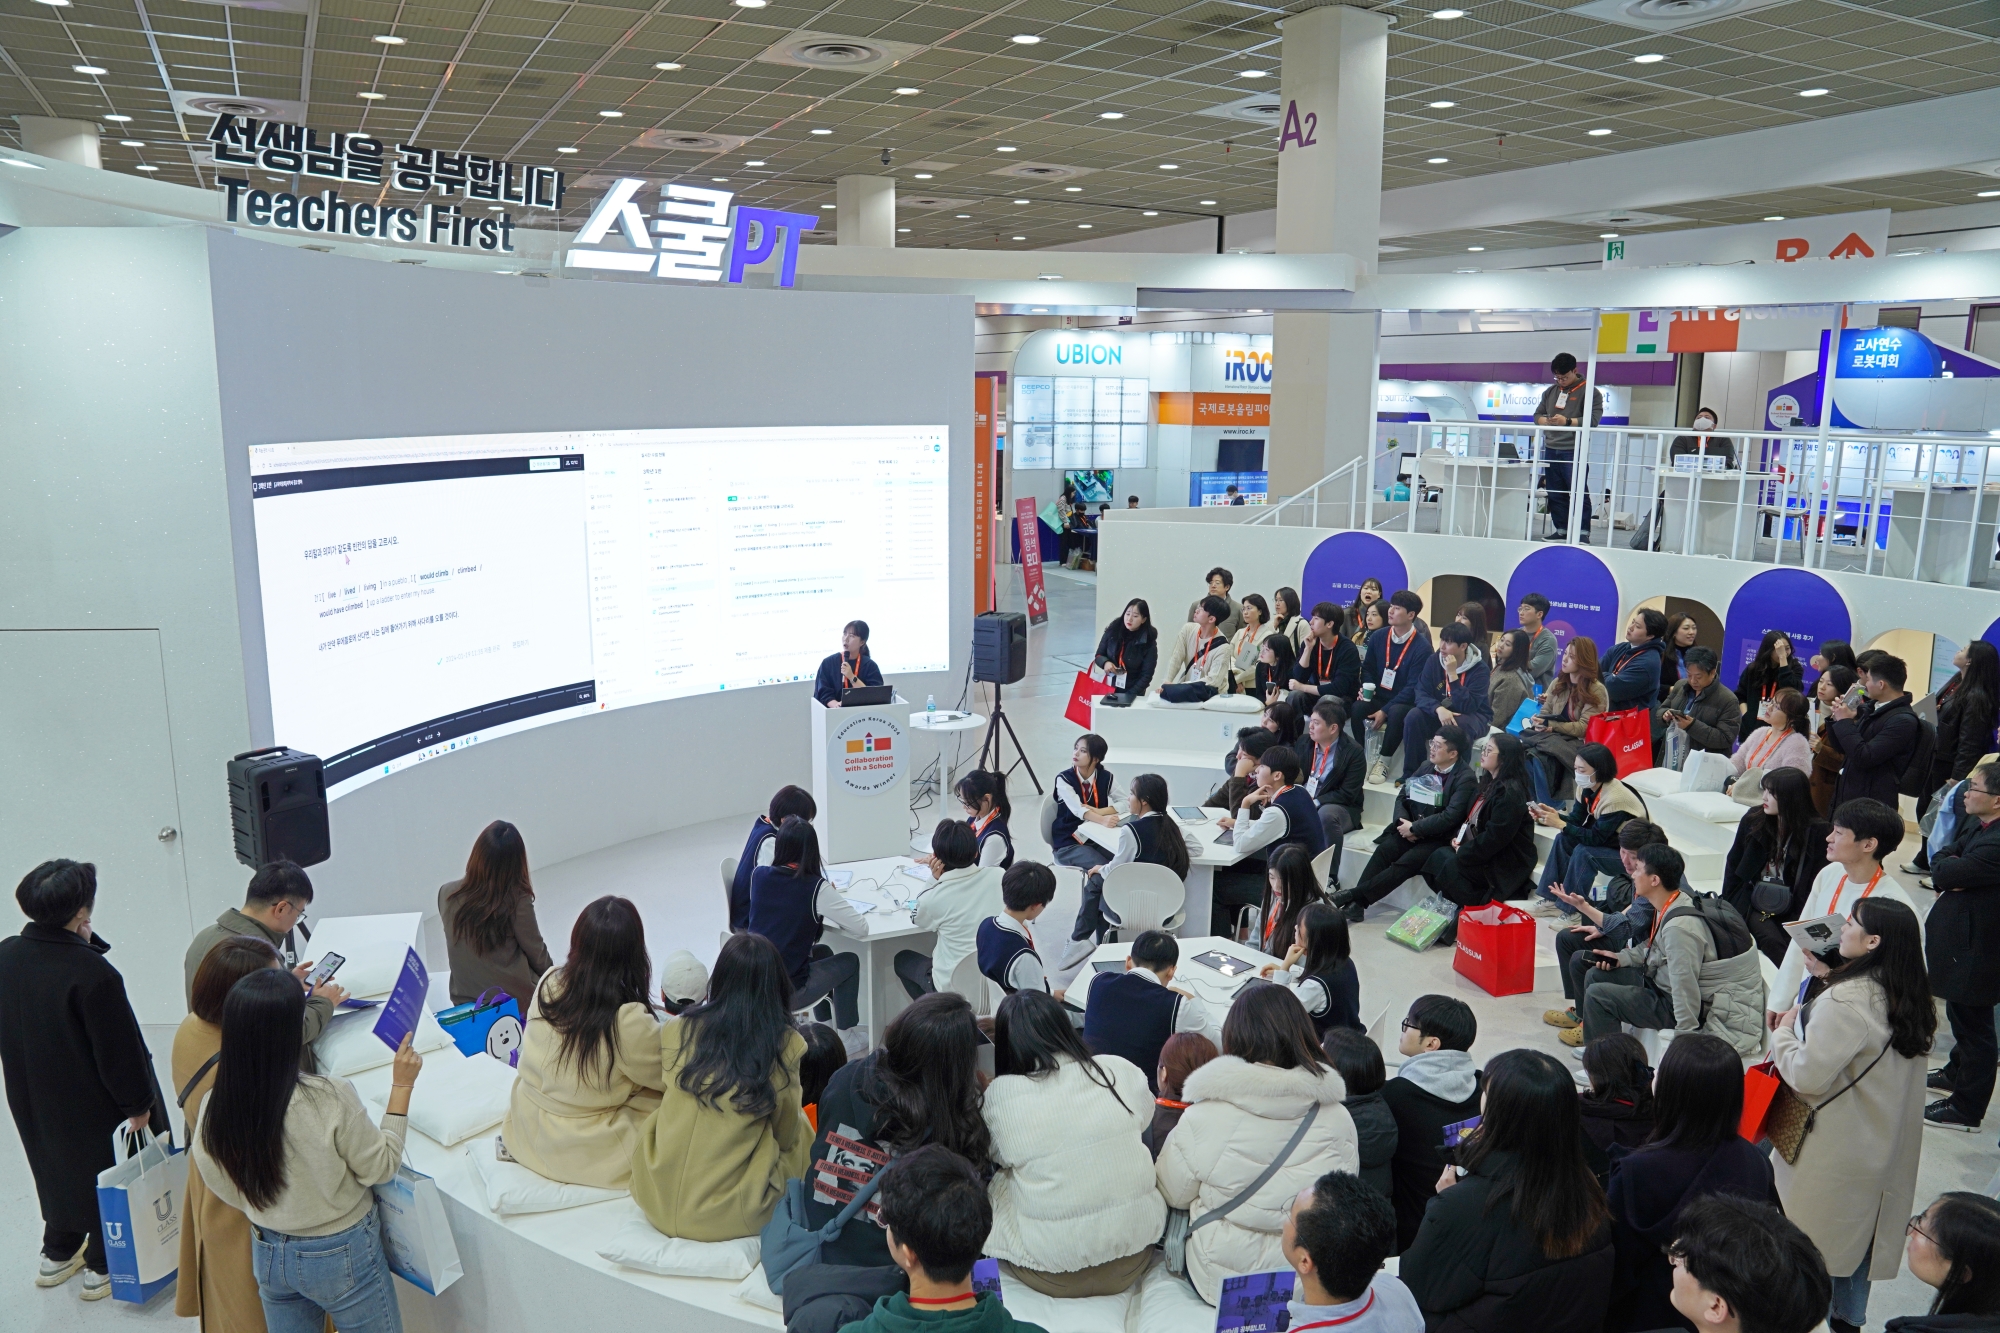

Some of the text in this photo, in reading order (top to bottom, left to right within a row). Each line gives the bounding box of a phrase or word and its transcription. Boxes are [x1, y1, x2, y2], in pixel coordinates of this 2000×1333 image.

[1279, 100, 1317, 152] A2
[207, 113, 565, 210] 선생님을 공부합니다
[215, 176, 515, 252] Teachers First
[1853, 337, 1902, 351] 교사연수
[1056, 343, 1122, 365] UBION
[1852, 354, 1899, 368] 로봇대회
[1022, 521, 1035, 536] 코딩
[837, 716, 901, 740] Education Korea 2024
[844, 755, 894, 765] Collaboration
[868, 762, 894, 771] School
[844, 772, 896, 791] Awards Winner
[1456, 940, 1482, 961] CLASSUM
[105, 1222, 122, 1240] U
[157, 1213, 178, 1233] CLASS
[108, 1239, 126, 1247] CLASS
